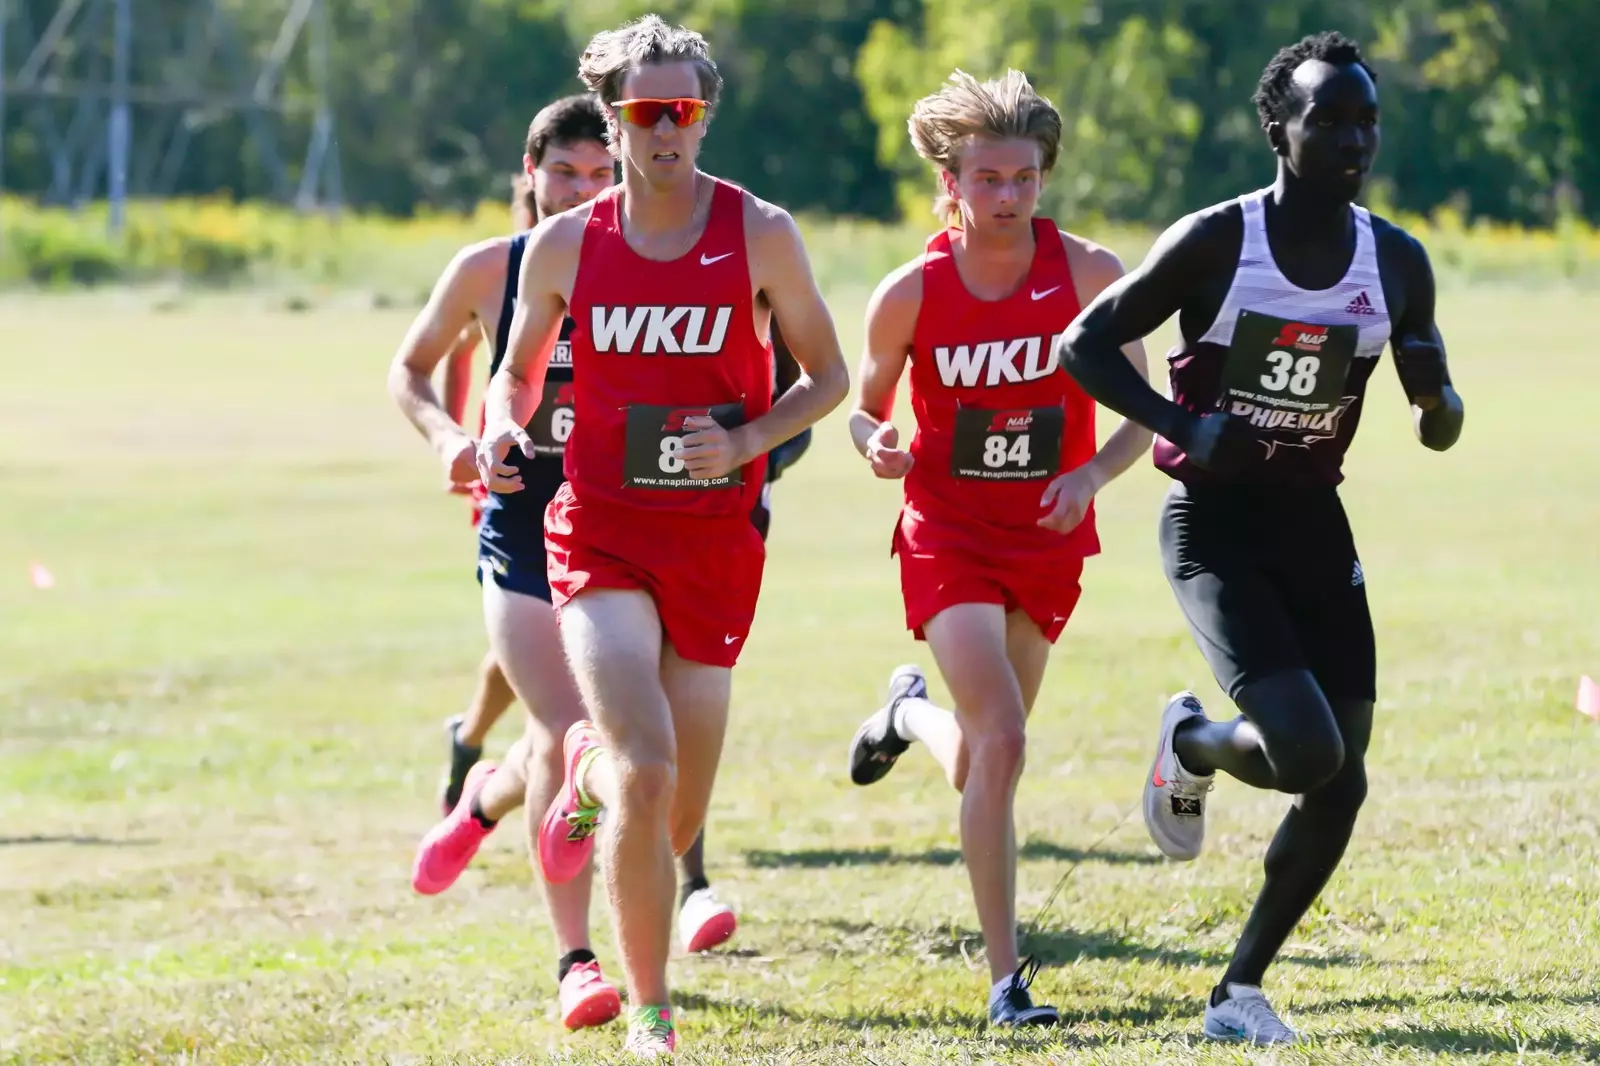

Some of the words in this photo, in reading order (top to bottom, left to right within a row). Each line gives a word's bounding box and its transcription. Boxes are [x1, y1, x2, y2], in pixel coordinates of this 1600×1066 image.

[1344, 305, 1376, 315] adidas
[590, 305, 733, 355] WKU
[934, 332, 1063, 388] WKU
[1260, 350, 1321, 396] 38
[1229, 388, 1330, 411] www.snaptiming.com
[982, 434, 1032, 468] 84
[633, 476, 729, 487] www.snaptiming.com
[959, 467, 1048, 479] www.snaptiming.com
